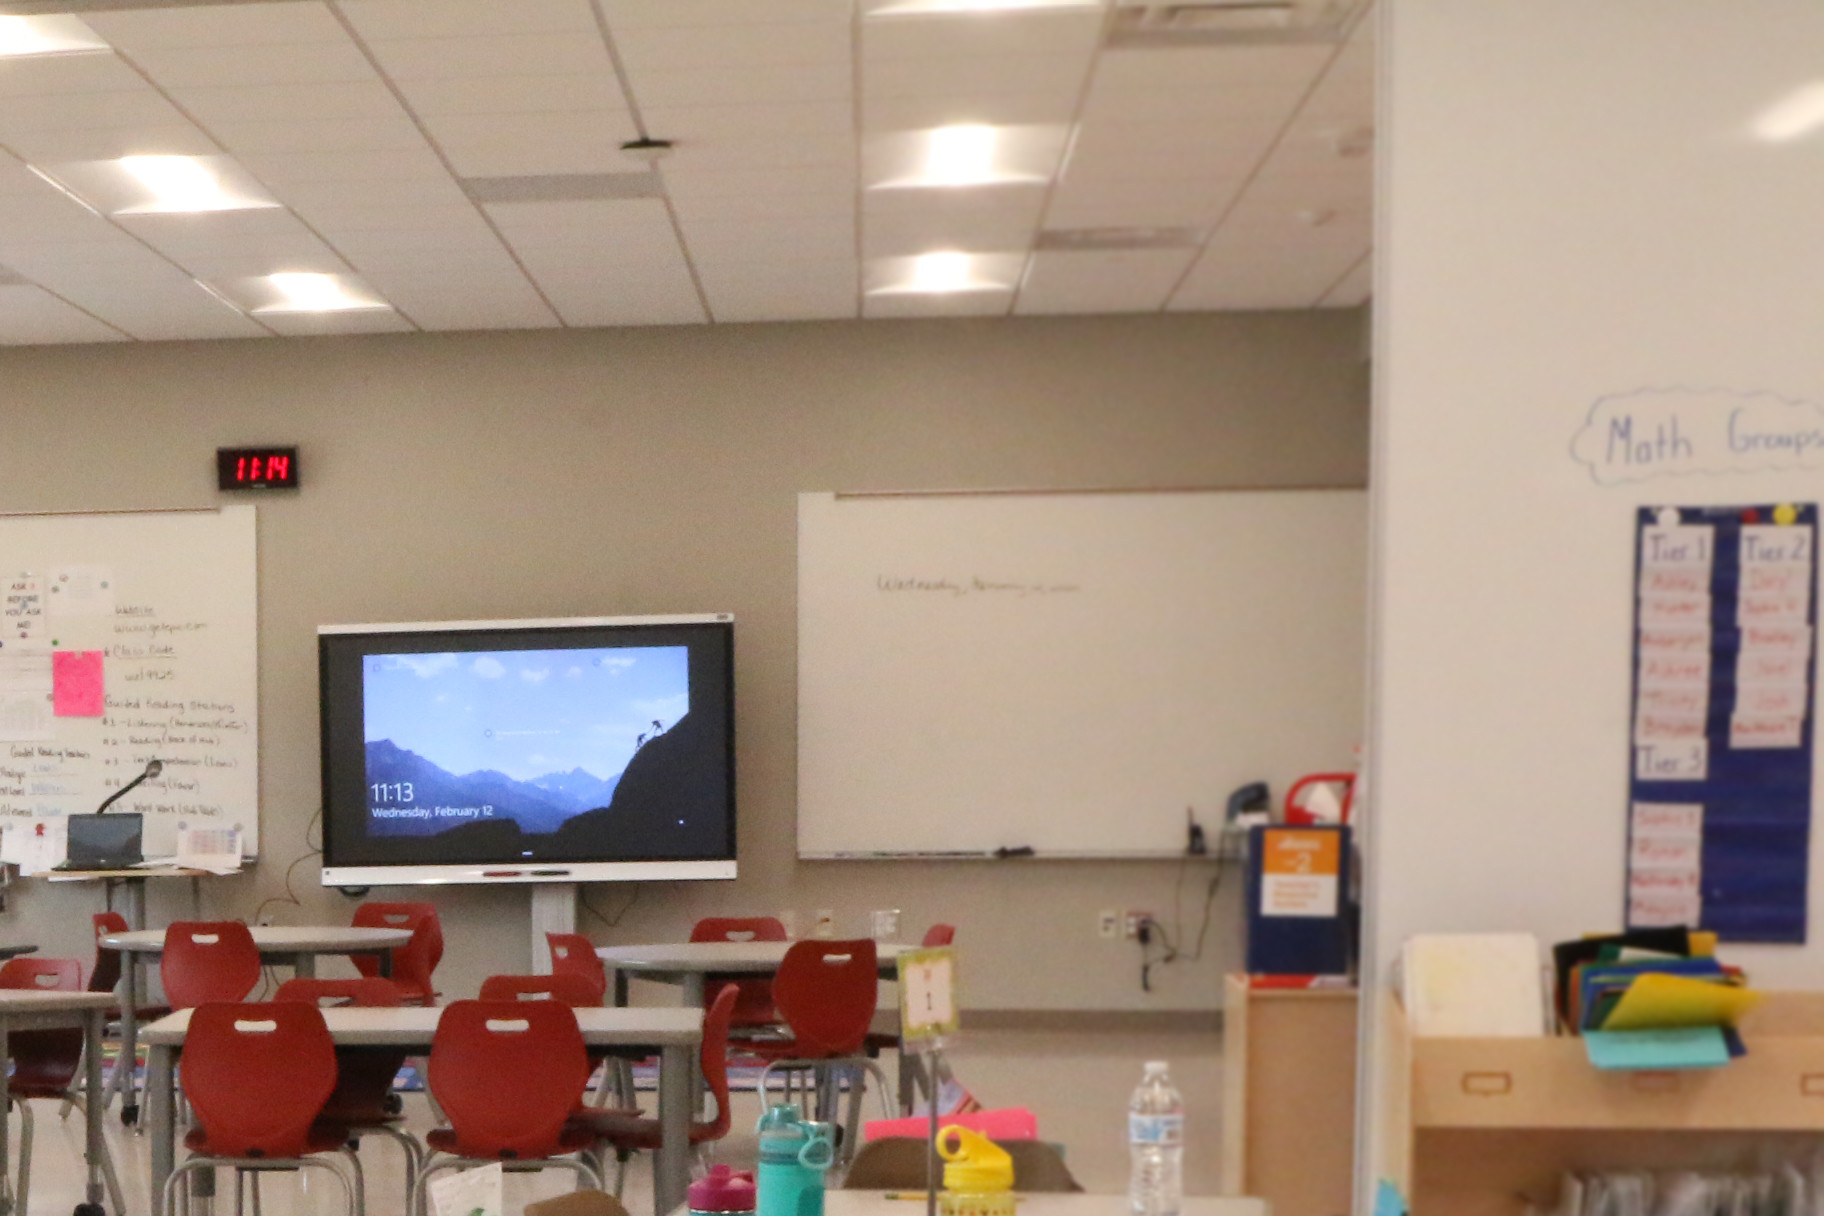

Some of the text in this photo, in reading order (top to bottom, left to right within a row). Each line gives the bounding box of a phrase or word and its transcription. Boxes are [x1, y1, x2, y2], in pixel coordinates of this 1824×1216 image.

[1605, 413, 1693, 465] Math
[237, 456, 289, 481] 11:14
[1650, 534, 1704, 561] Tier 1
[1745, 533, 1806, 561] Tier 2
[1638, 745, 1702, 773] Tier 3
[371, 782, 414, 802] 11:13
[372, 805, 493, 819] Wednesday, February 12
[926, 991, 932, 1011] 1
